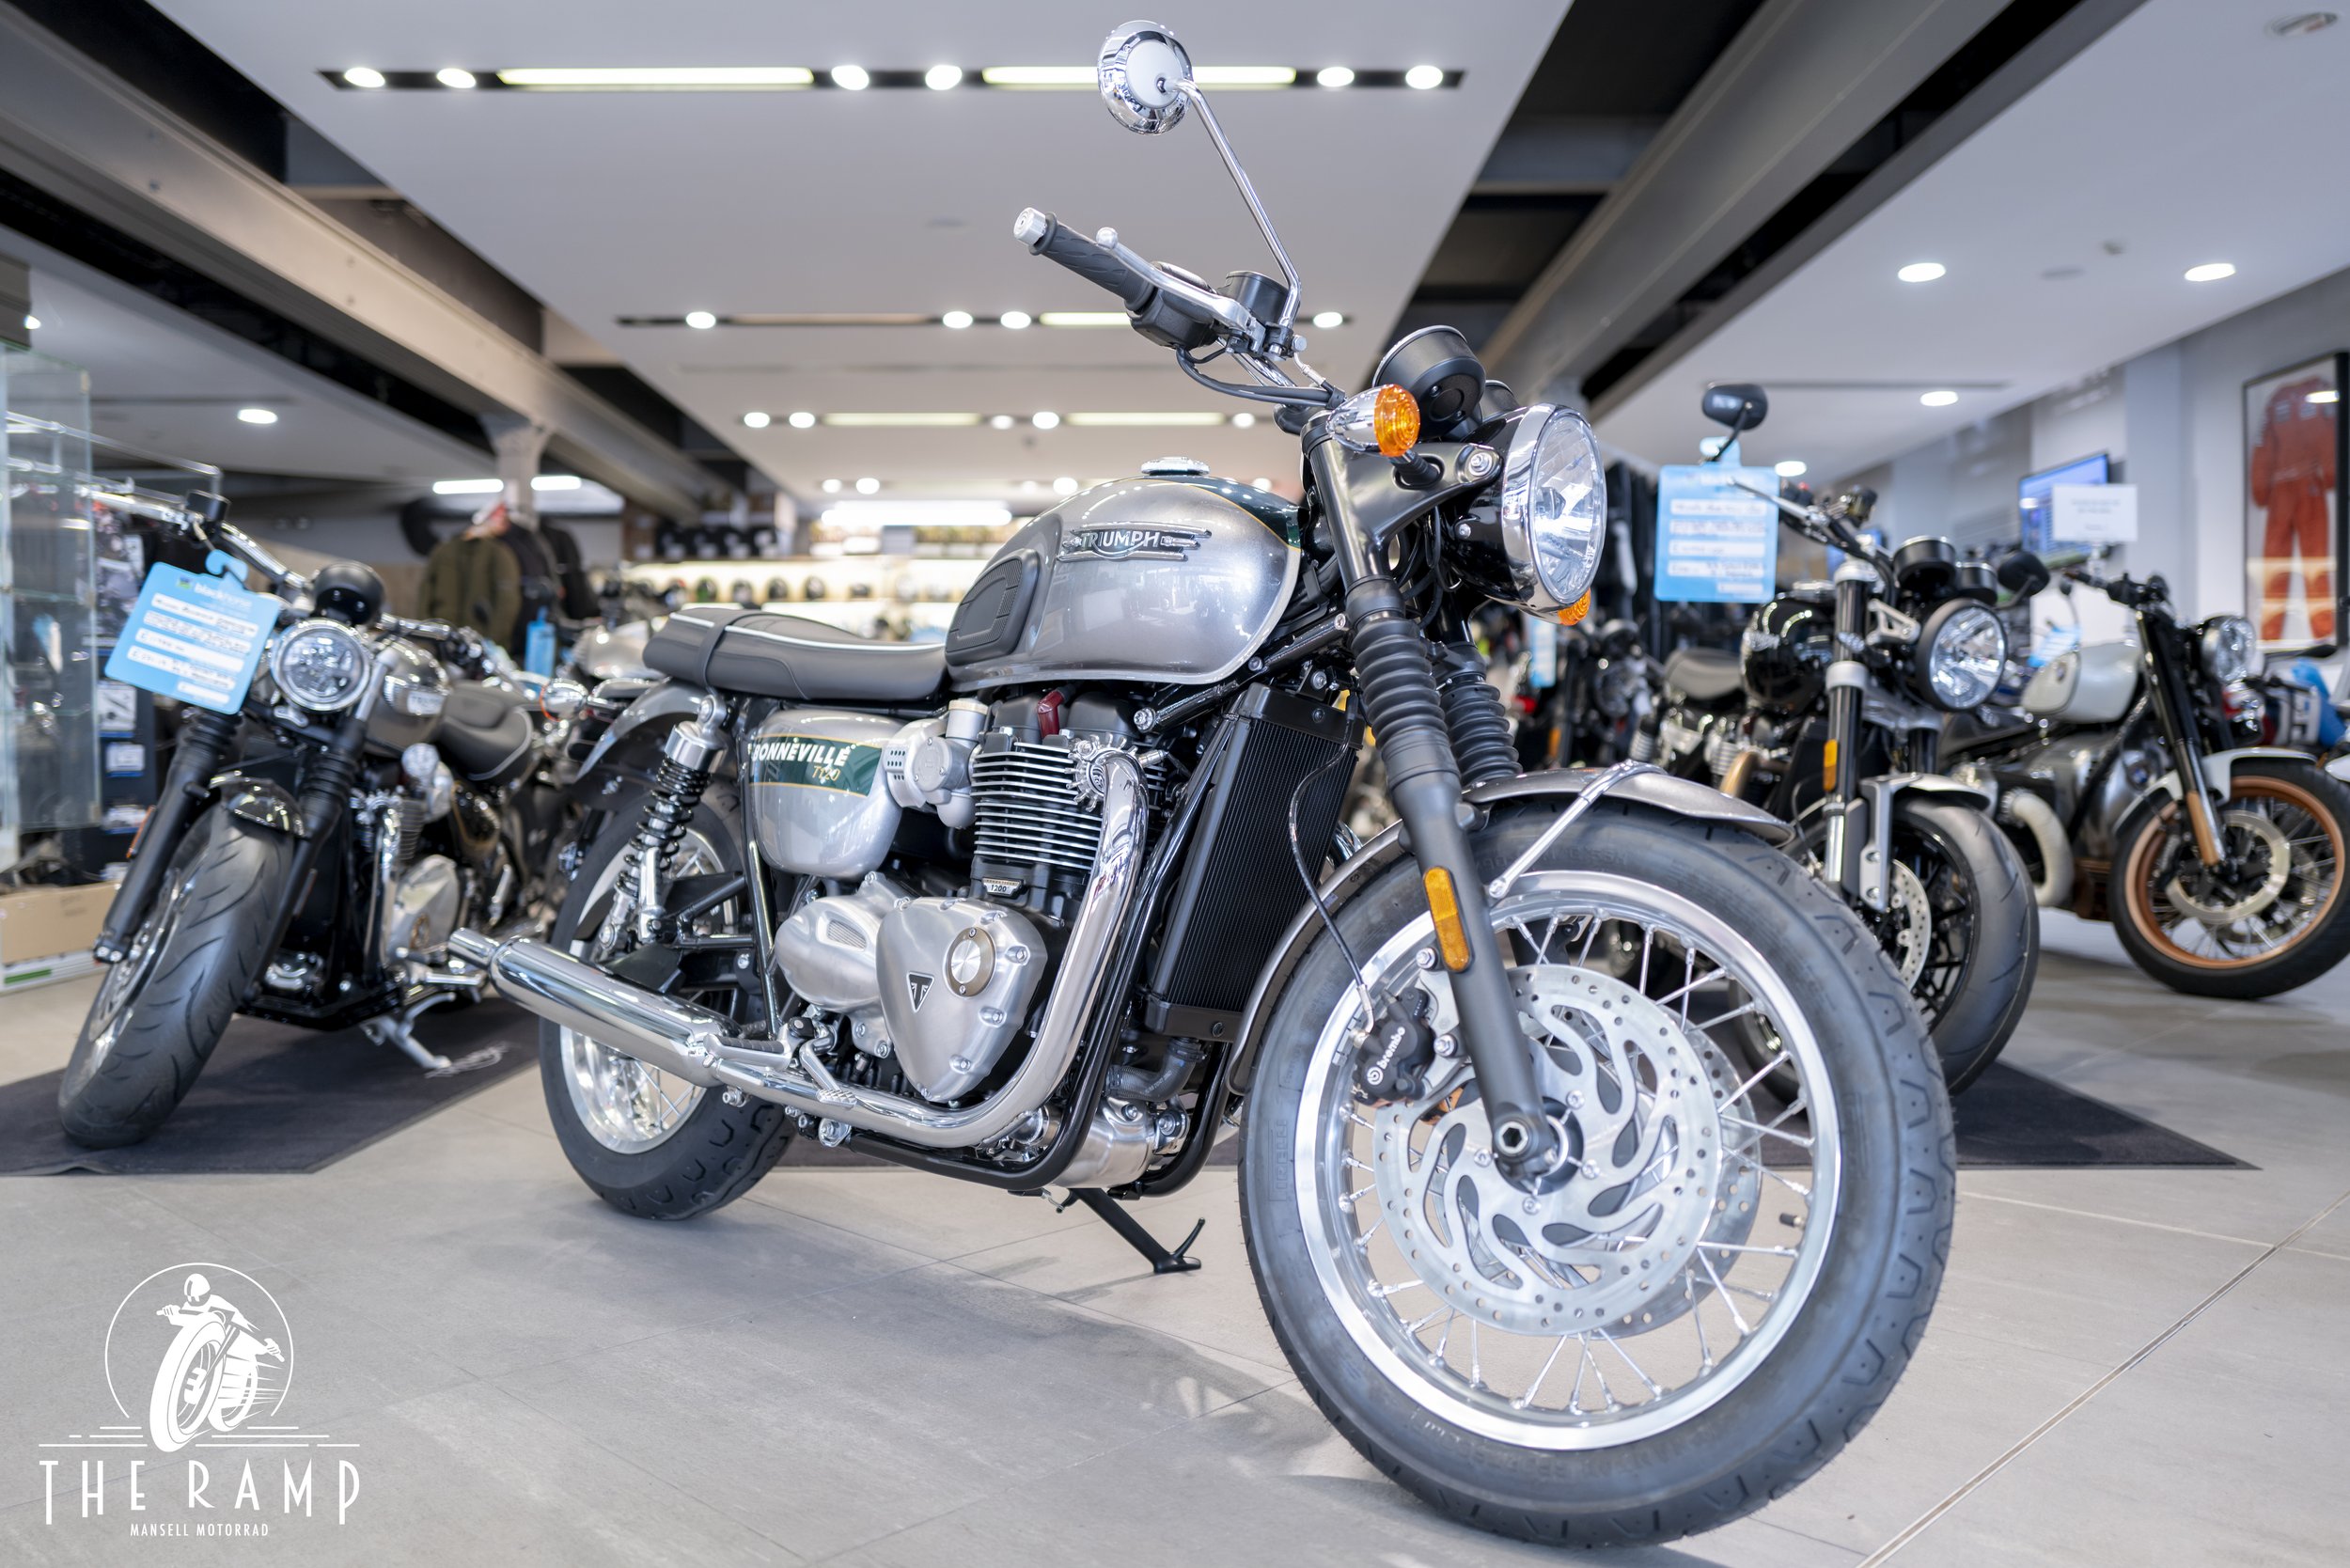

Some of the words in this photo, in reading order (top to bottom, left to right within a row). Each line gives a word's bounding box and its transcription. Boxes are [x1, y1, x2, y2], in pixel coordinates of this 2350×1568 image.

[1081, 530, 1161, 548] TRIUMPH
[752, 742, 852, 767] BONNEVILLE
[990, 884, 1008, 893] 1200
[1376, 1027, 1406, 1070] brembo
